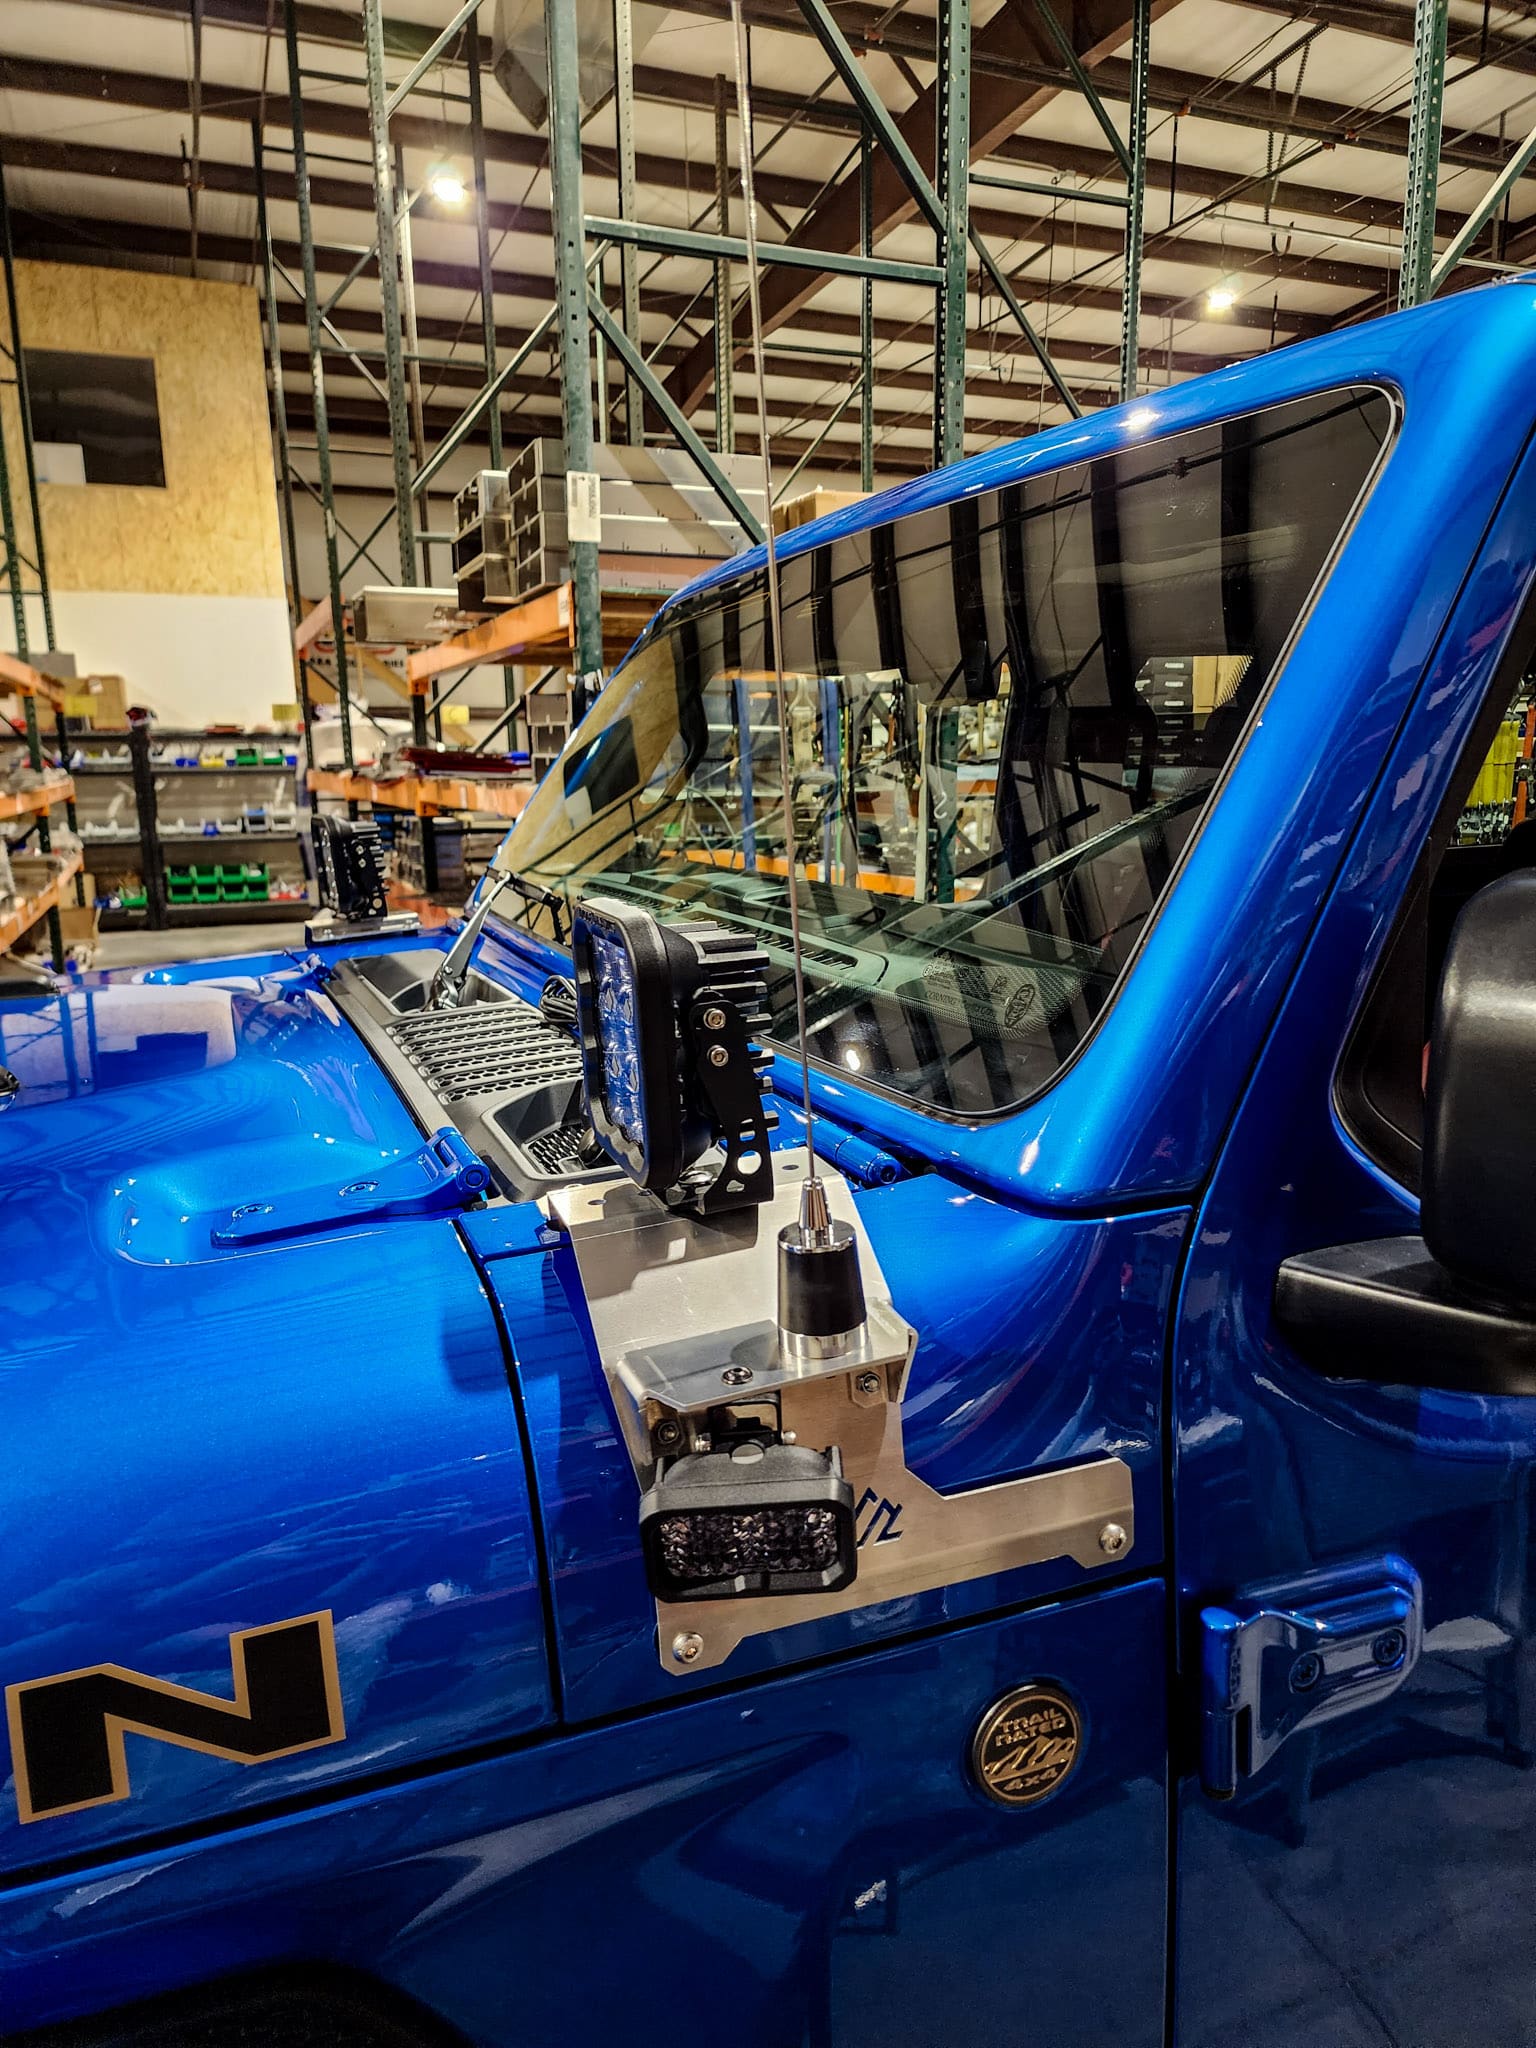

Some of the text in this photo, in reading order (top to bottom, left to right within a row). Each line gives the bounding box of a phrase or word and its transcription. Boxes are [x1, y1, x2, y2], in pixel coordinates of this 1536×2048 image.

[5, 1609, 346, 1824] N
[1000, 1708, 1062, 1733] TRAIL
[995, 1717, 1066, 1747] RATED
